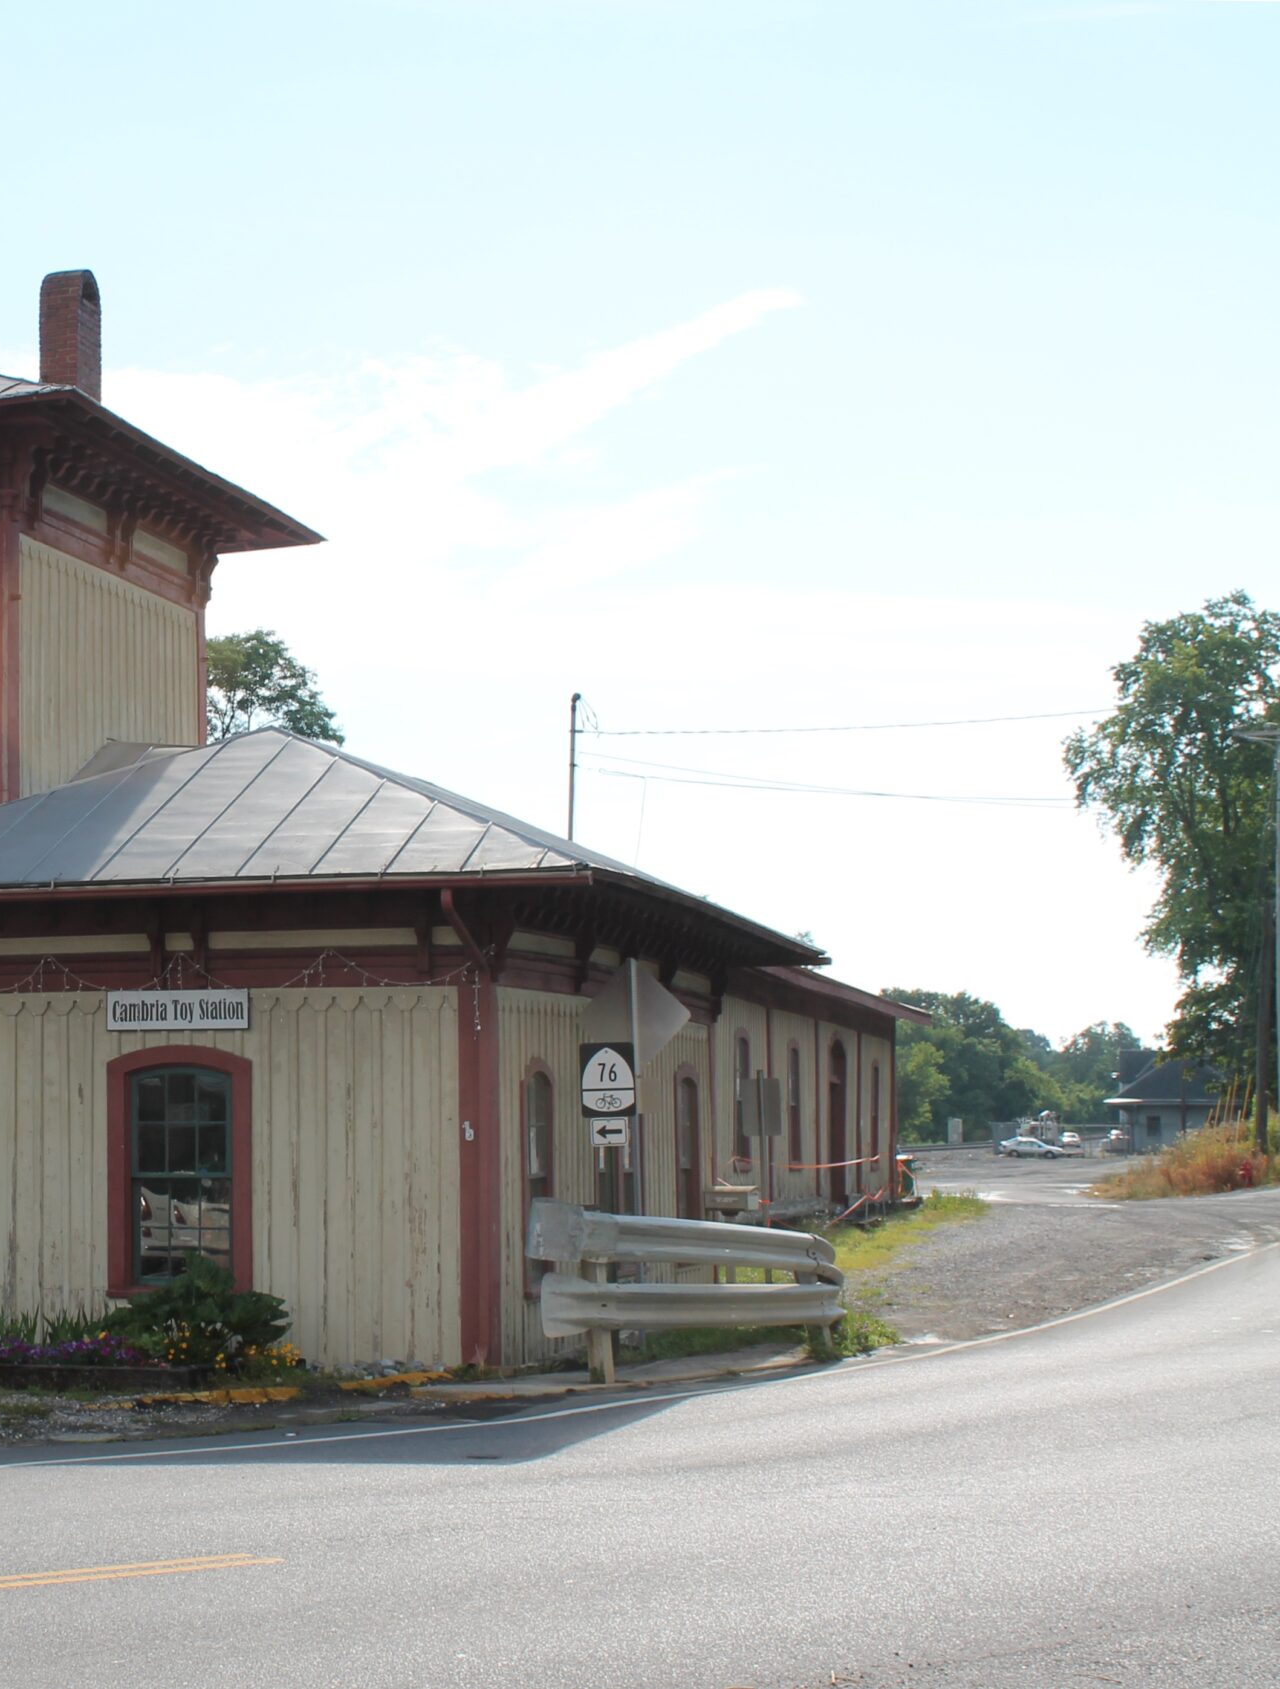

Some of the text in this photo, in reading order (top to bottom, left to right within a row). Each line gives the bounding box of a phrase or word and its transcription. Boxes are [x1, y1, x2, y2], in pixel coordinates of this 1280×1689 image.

[112, 998, 244, 1024] Cambria Toy Station
[597, 1063, 618, 1082] 76
